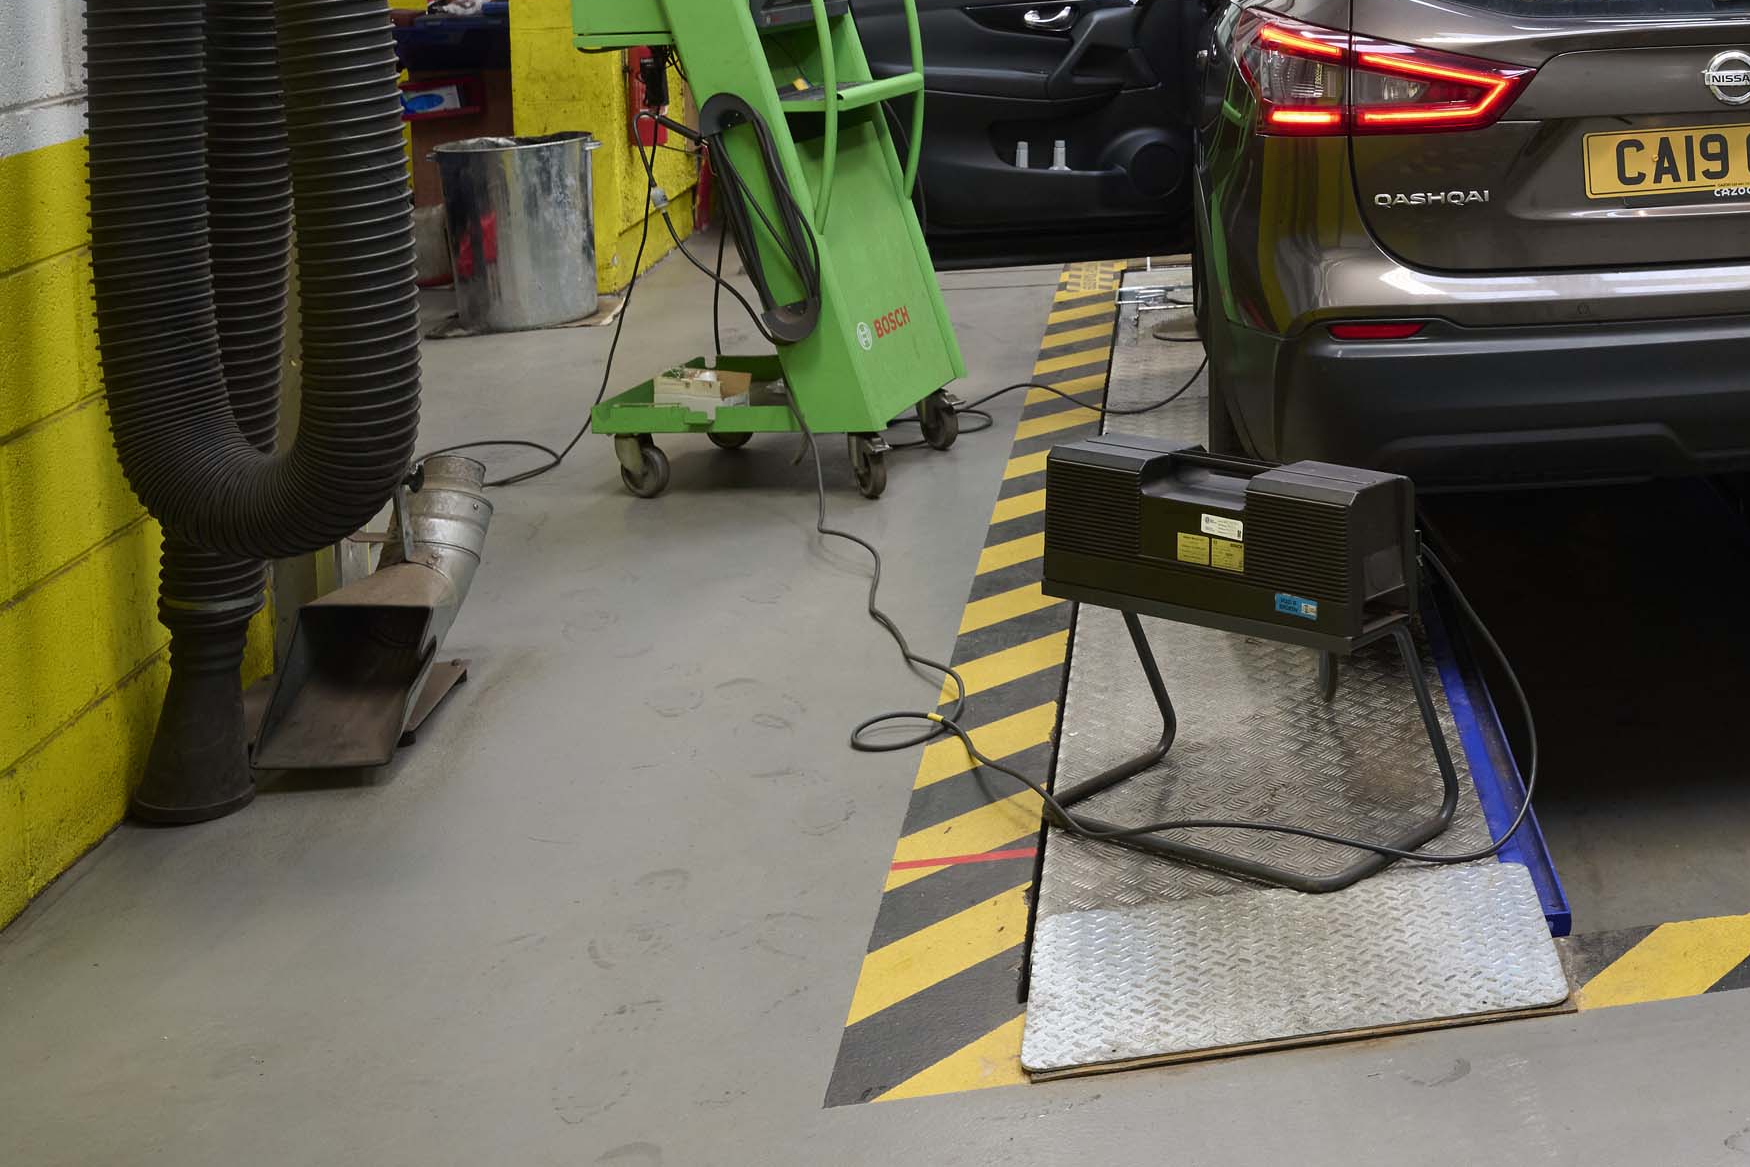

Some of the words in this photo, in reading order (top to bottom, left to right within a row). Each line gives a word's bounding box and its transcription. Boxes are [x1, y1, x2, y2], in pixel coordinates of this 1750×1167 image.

[1616, 133, 1730, 185] CA19
[1374, 190, 1490, 208] QASHQAI
[873, 305, 911, 339] BOSCH
